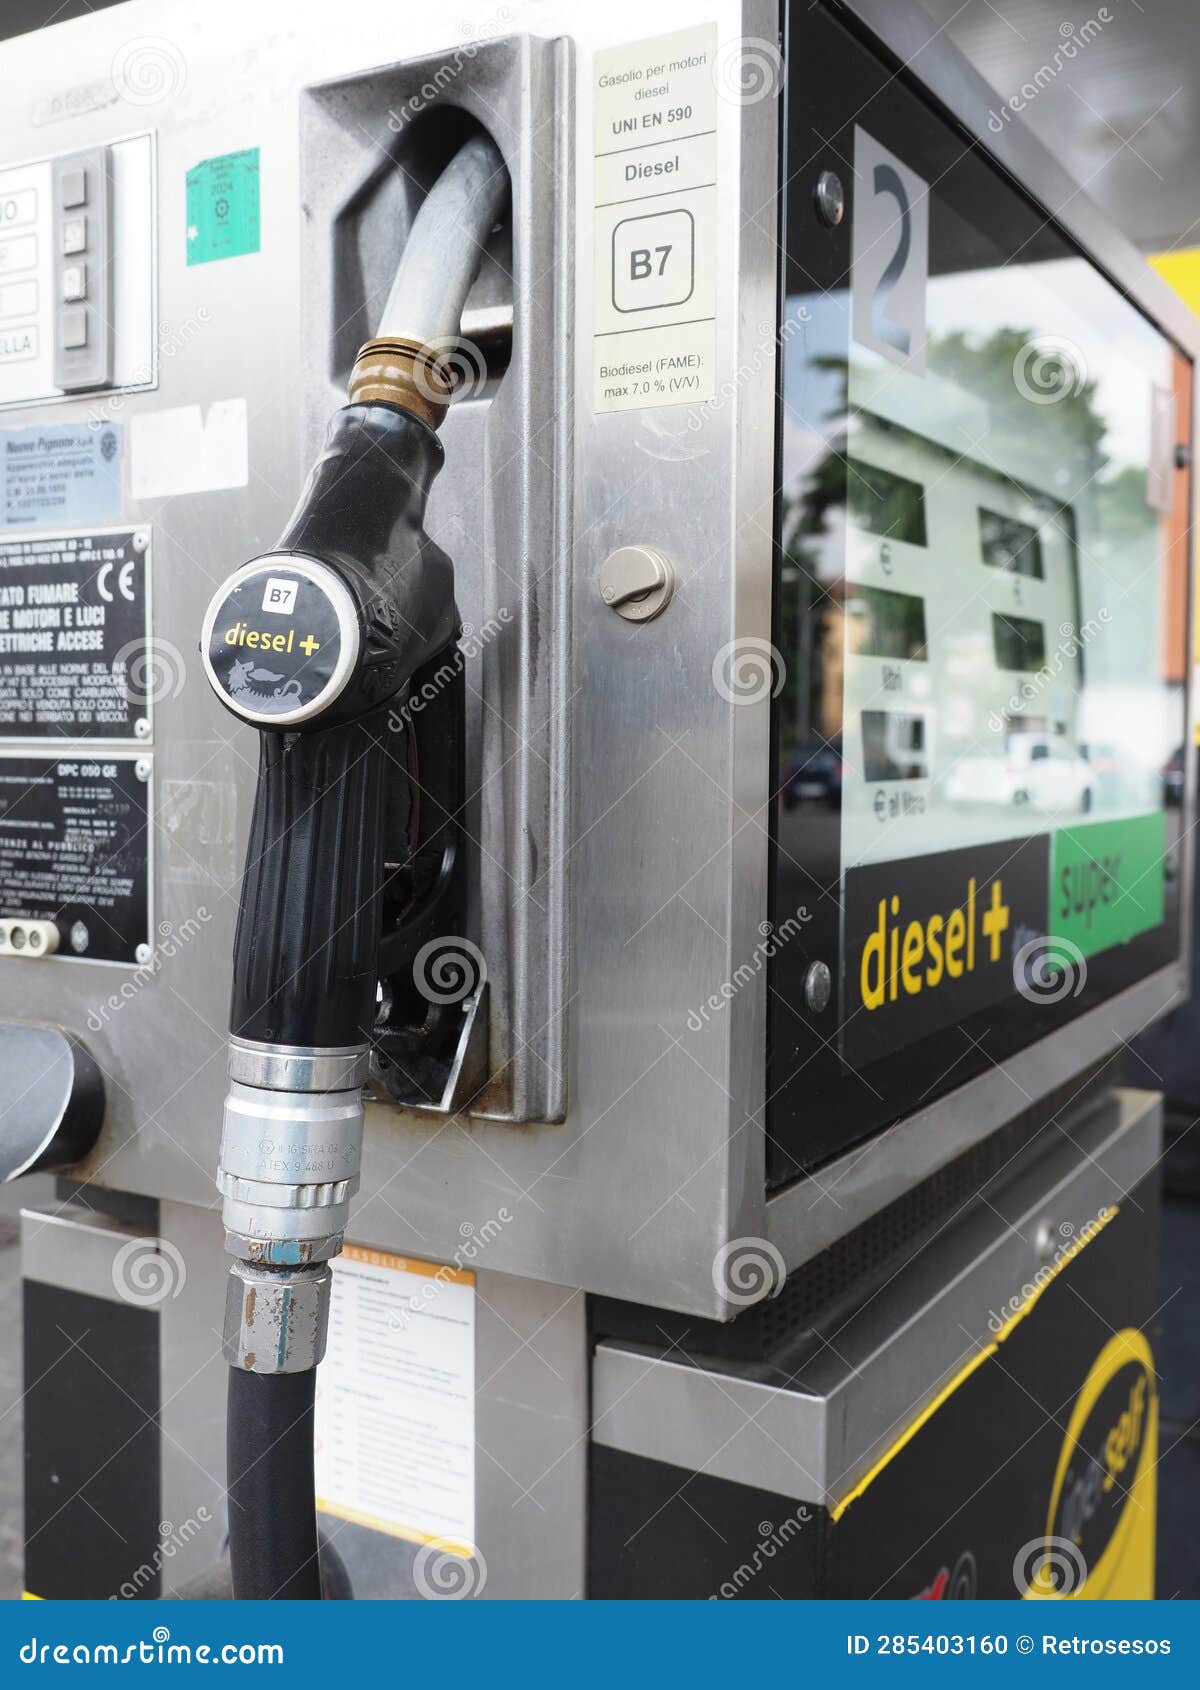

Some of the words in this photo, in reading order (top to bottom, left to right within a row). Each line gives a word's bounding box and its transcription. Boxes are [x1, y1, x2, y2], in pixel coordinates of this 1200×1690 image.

[598, 70, 643, 89] Gasolio
[646, 64, 666, 79] per
[669, 52, 707, 72] motori
[634, 80, 669, 101] diesel
[612, 117, 638, 135] UNI
[642, 111, 662, 129] EN
[667, 105, 693, 123] 590
[625, 155, 680, 182] Diesel
[630, 244, 673, 281] B7
[600, 361, 652, 379] Biodiesel
[656, 354, 704, 374] (FAME):
[604, 384, 628, 399] max
[632, 380, 650, 396] 7,0
[654, 377, 666, 392] %
[669, 374, 700, 391] (V/V)
[27, 582, 79, 605] FUMARE
[270, 588, 292, 604] B7
[12, 608, 60, 629] MOTORI
[63, 606, 73, 628] E
[76, 605, 105, 627] LUCI
[57, 629, 104, 651] ACCESE
